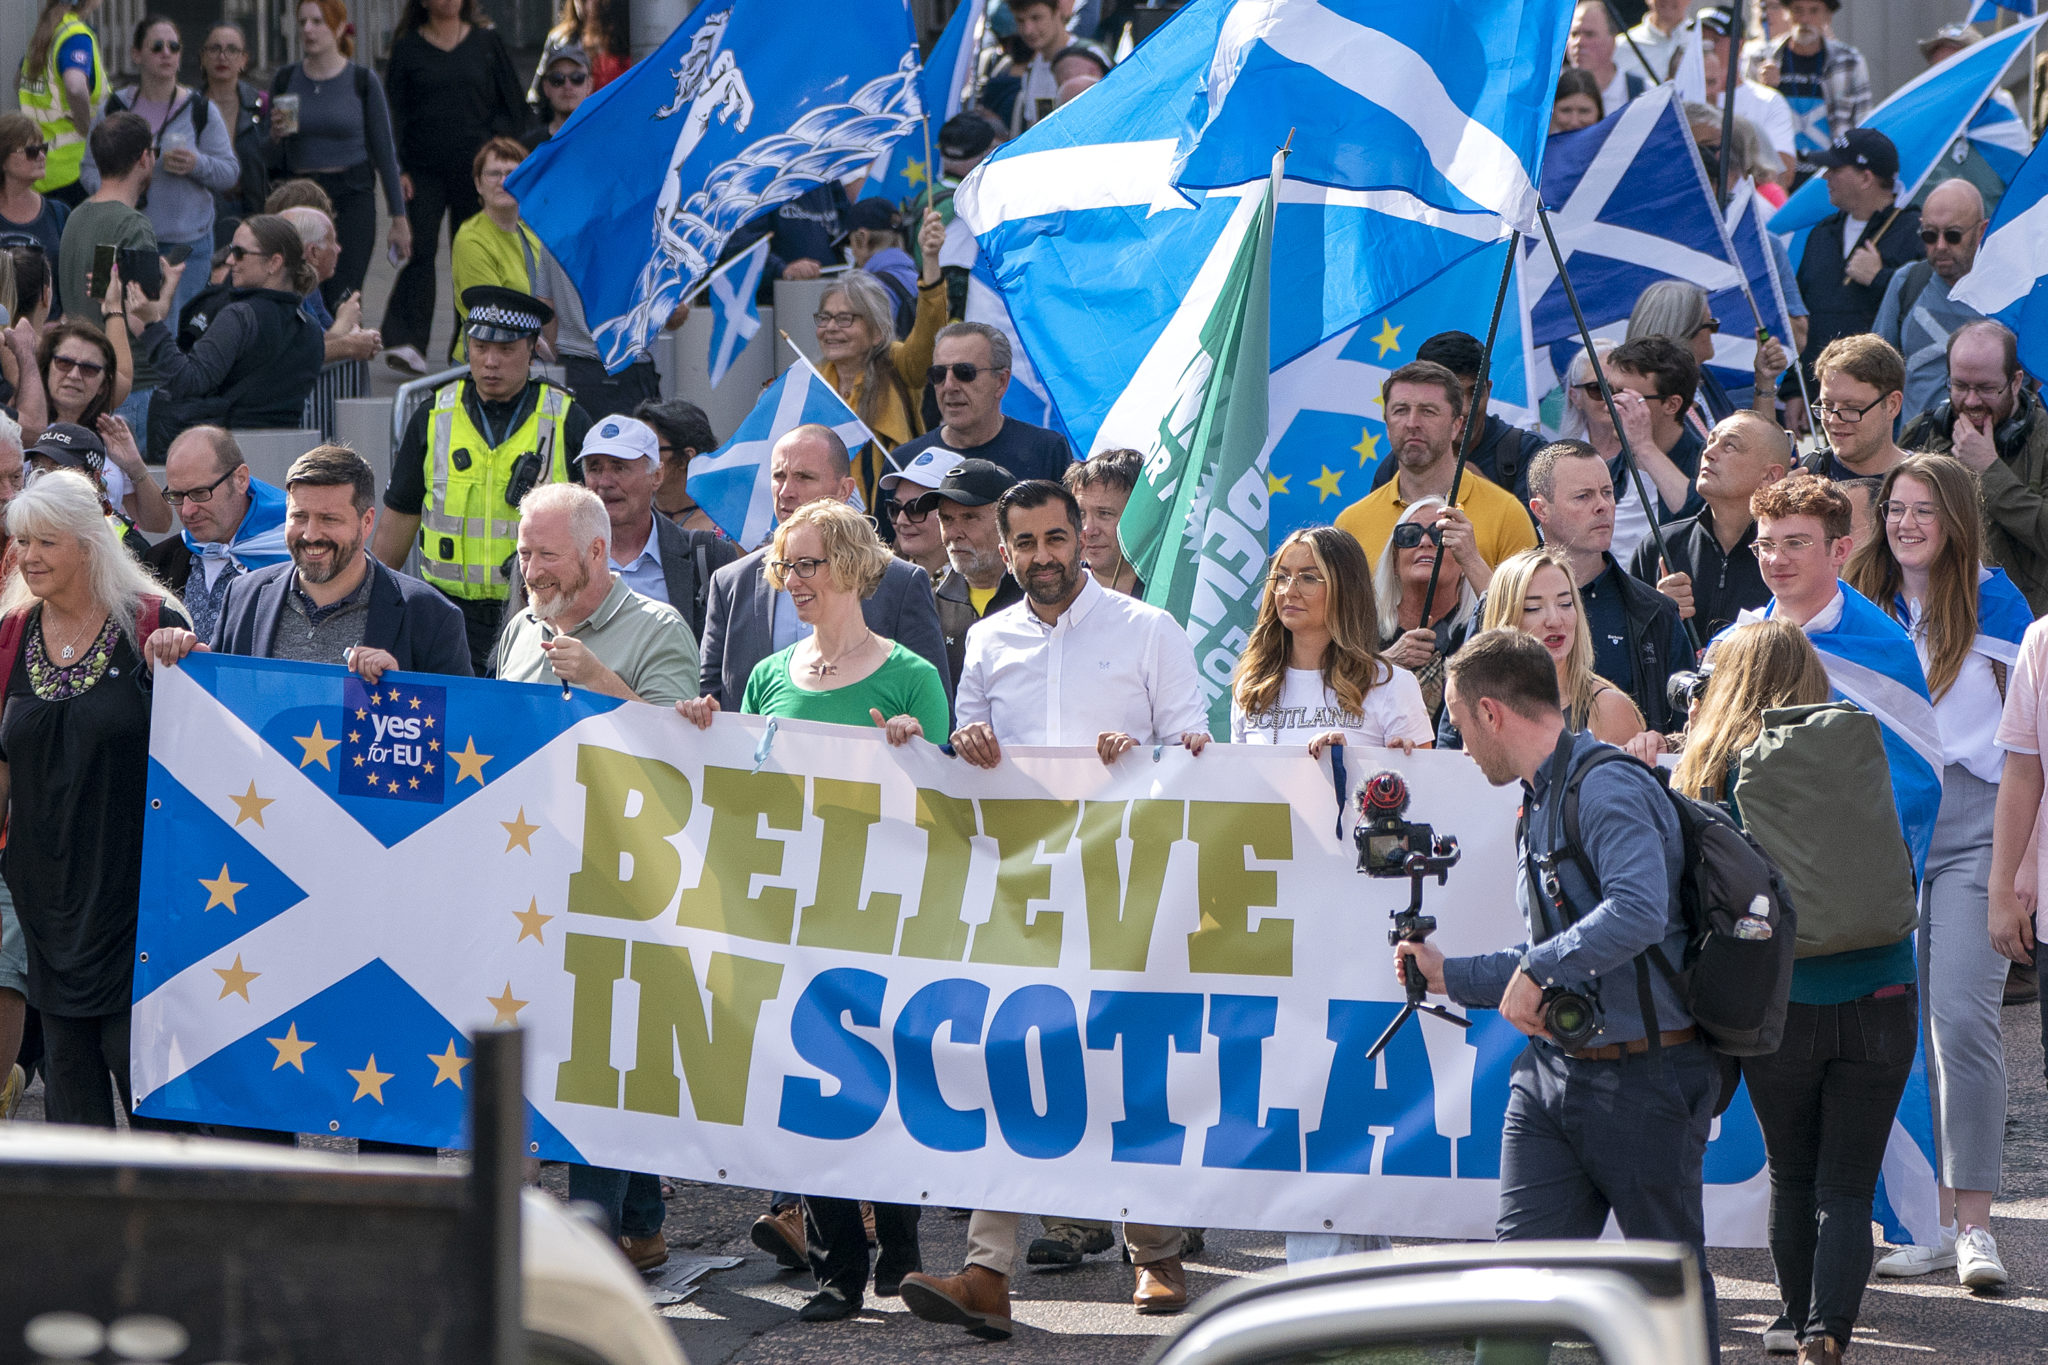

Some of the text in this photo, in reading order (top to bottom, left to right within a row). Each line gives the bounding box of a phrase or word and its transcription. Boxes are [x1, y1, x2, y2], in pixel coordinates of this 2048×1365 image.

[371, 713, 421, 743] yes
[1245, 706, 1365, 729] SCOTLAND
[366, 742, 422, 767] for EU
[567, 742, 1295, 978] BELIEVE
[554, 931, 1768, 1186] IN SCOTLA
